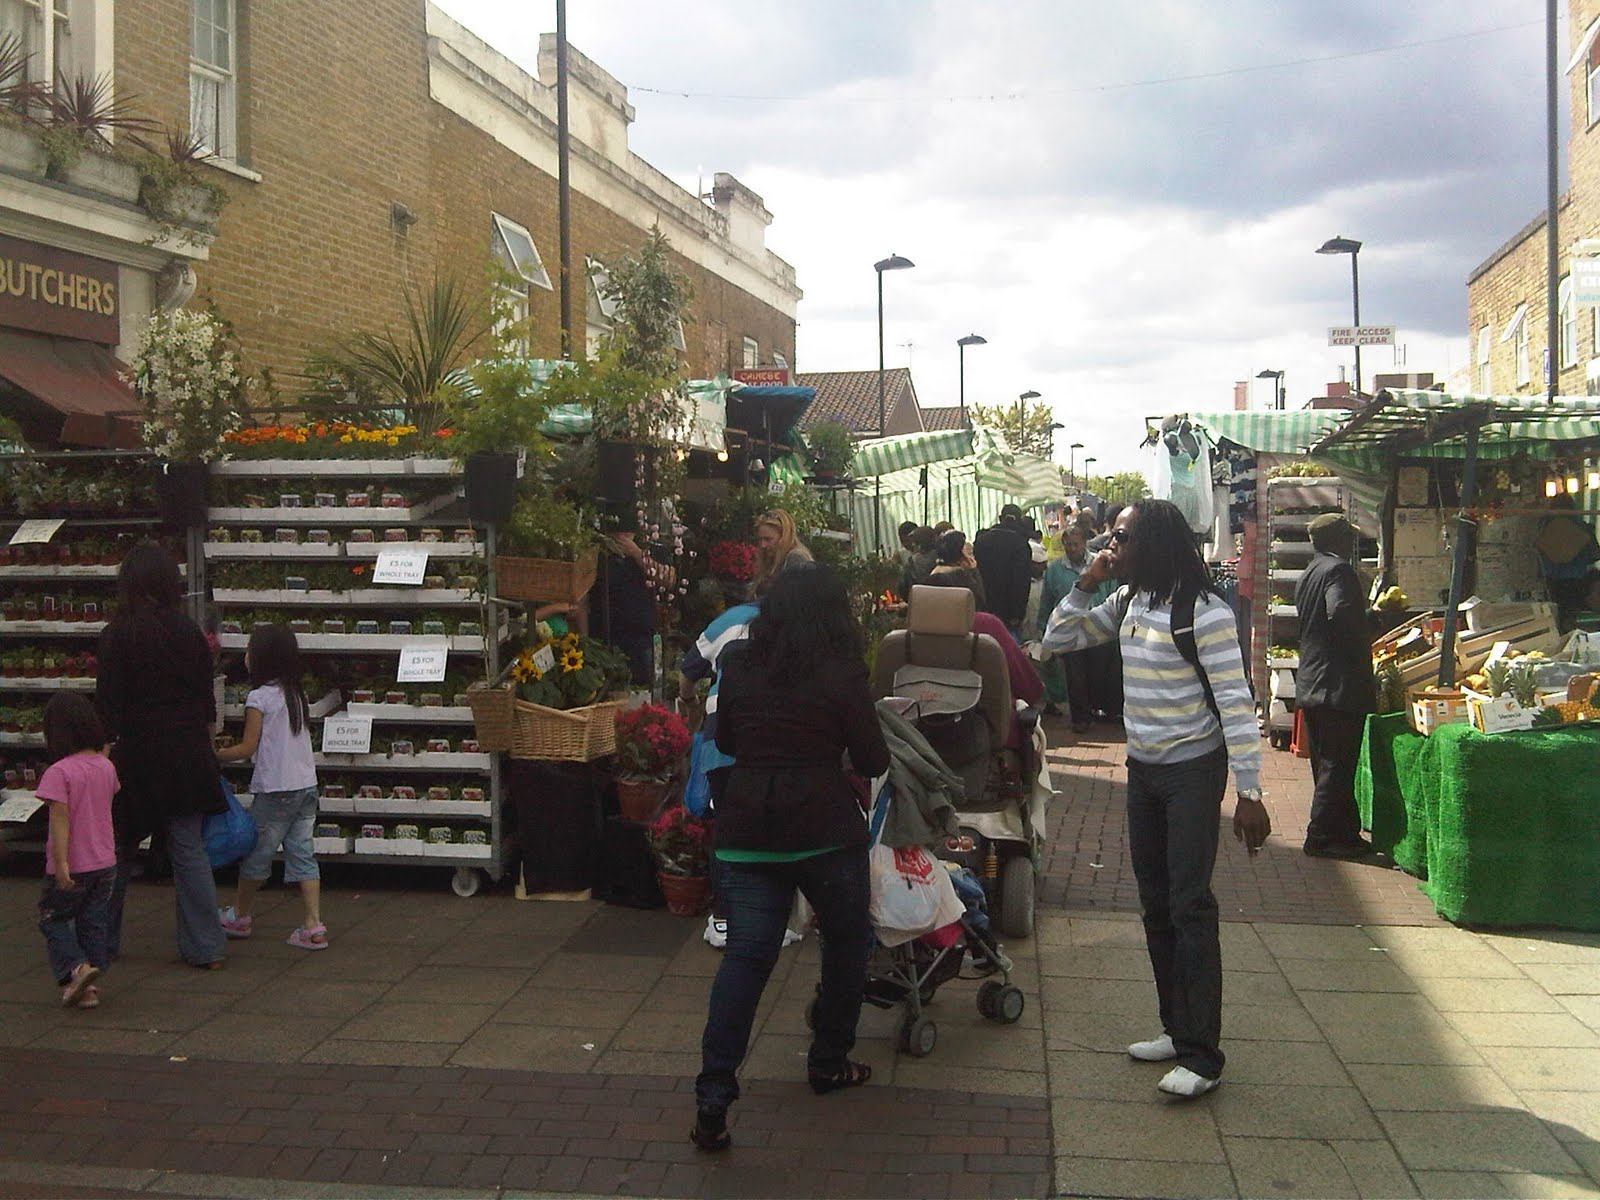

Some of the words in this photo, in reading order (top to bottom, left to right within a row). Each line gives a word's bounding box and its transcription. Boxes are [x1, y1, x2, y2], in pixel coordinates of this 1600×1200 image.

[1356, 327, 1391, 336] ACCESS
[1359, 336, 1388, 344] CLEAR
[740, 371, 781, 381] CHINESE
[426, 667, 441, 675] TRAY
